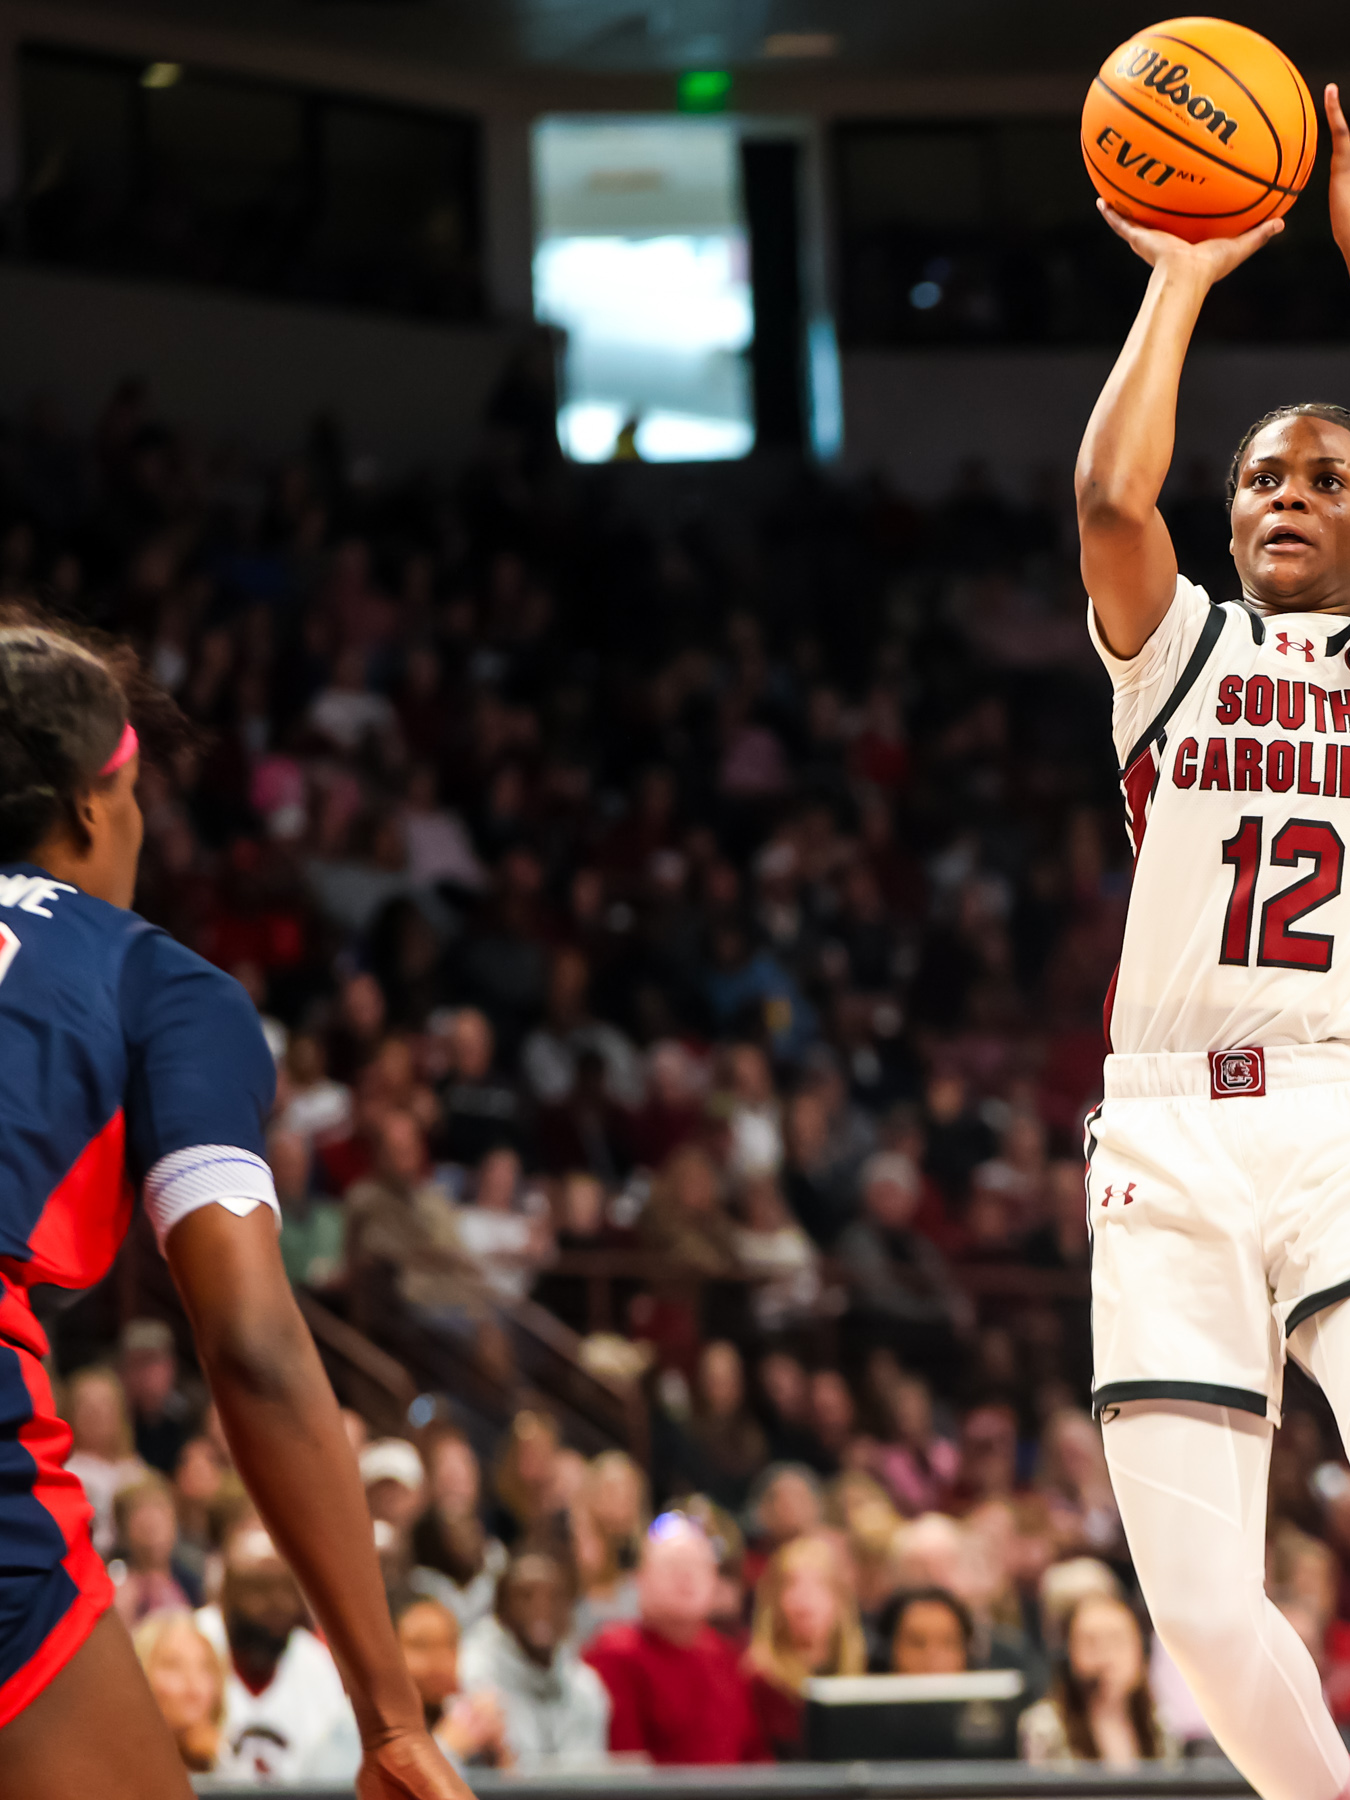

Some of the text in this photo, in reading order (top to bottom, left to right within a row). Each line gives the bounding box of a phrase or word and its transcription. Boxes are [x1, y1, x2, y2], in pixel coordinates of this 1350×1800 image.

[1116, 45, 1238, 146] Wilson
[1096, 125, 1176, 187] EVO
[1218, 815, 1346, 973] 12
